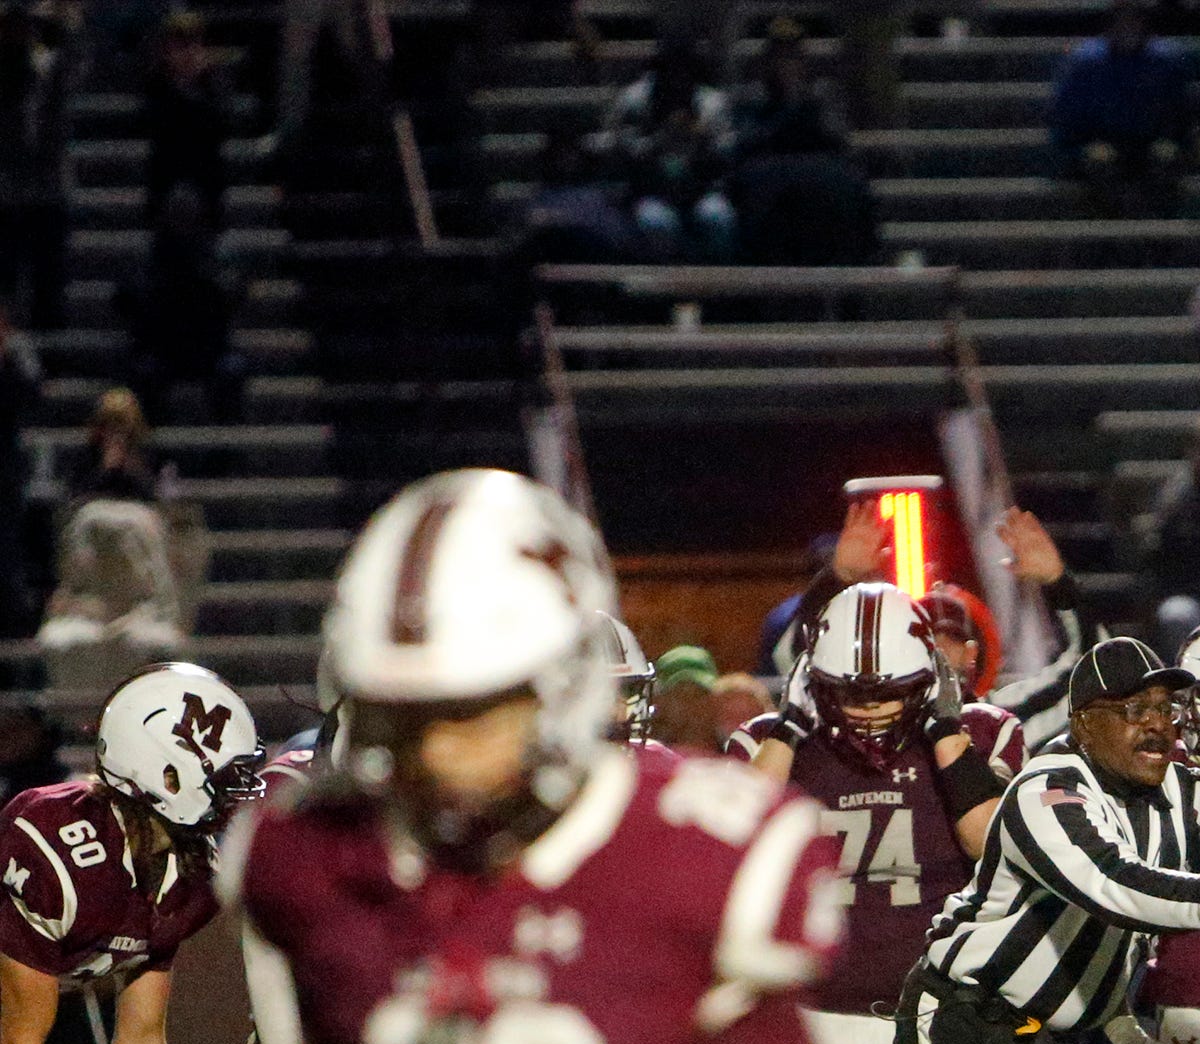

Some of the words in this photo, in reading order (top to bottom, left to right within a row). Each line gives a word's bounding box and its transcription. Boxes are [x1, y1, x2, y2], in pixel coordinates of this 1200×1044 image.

[880, 492, 925, 600] 1
[172, 692, 232, 753] M
[839, 791, 904, 808] CAVEMEN
[58, 819, 108, 868] 60
[818, 809, 922, 906] 74
